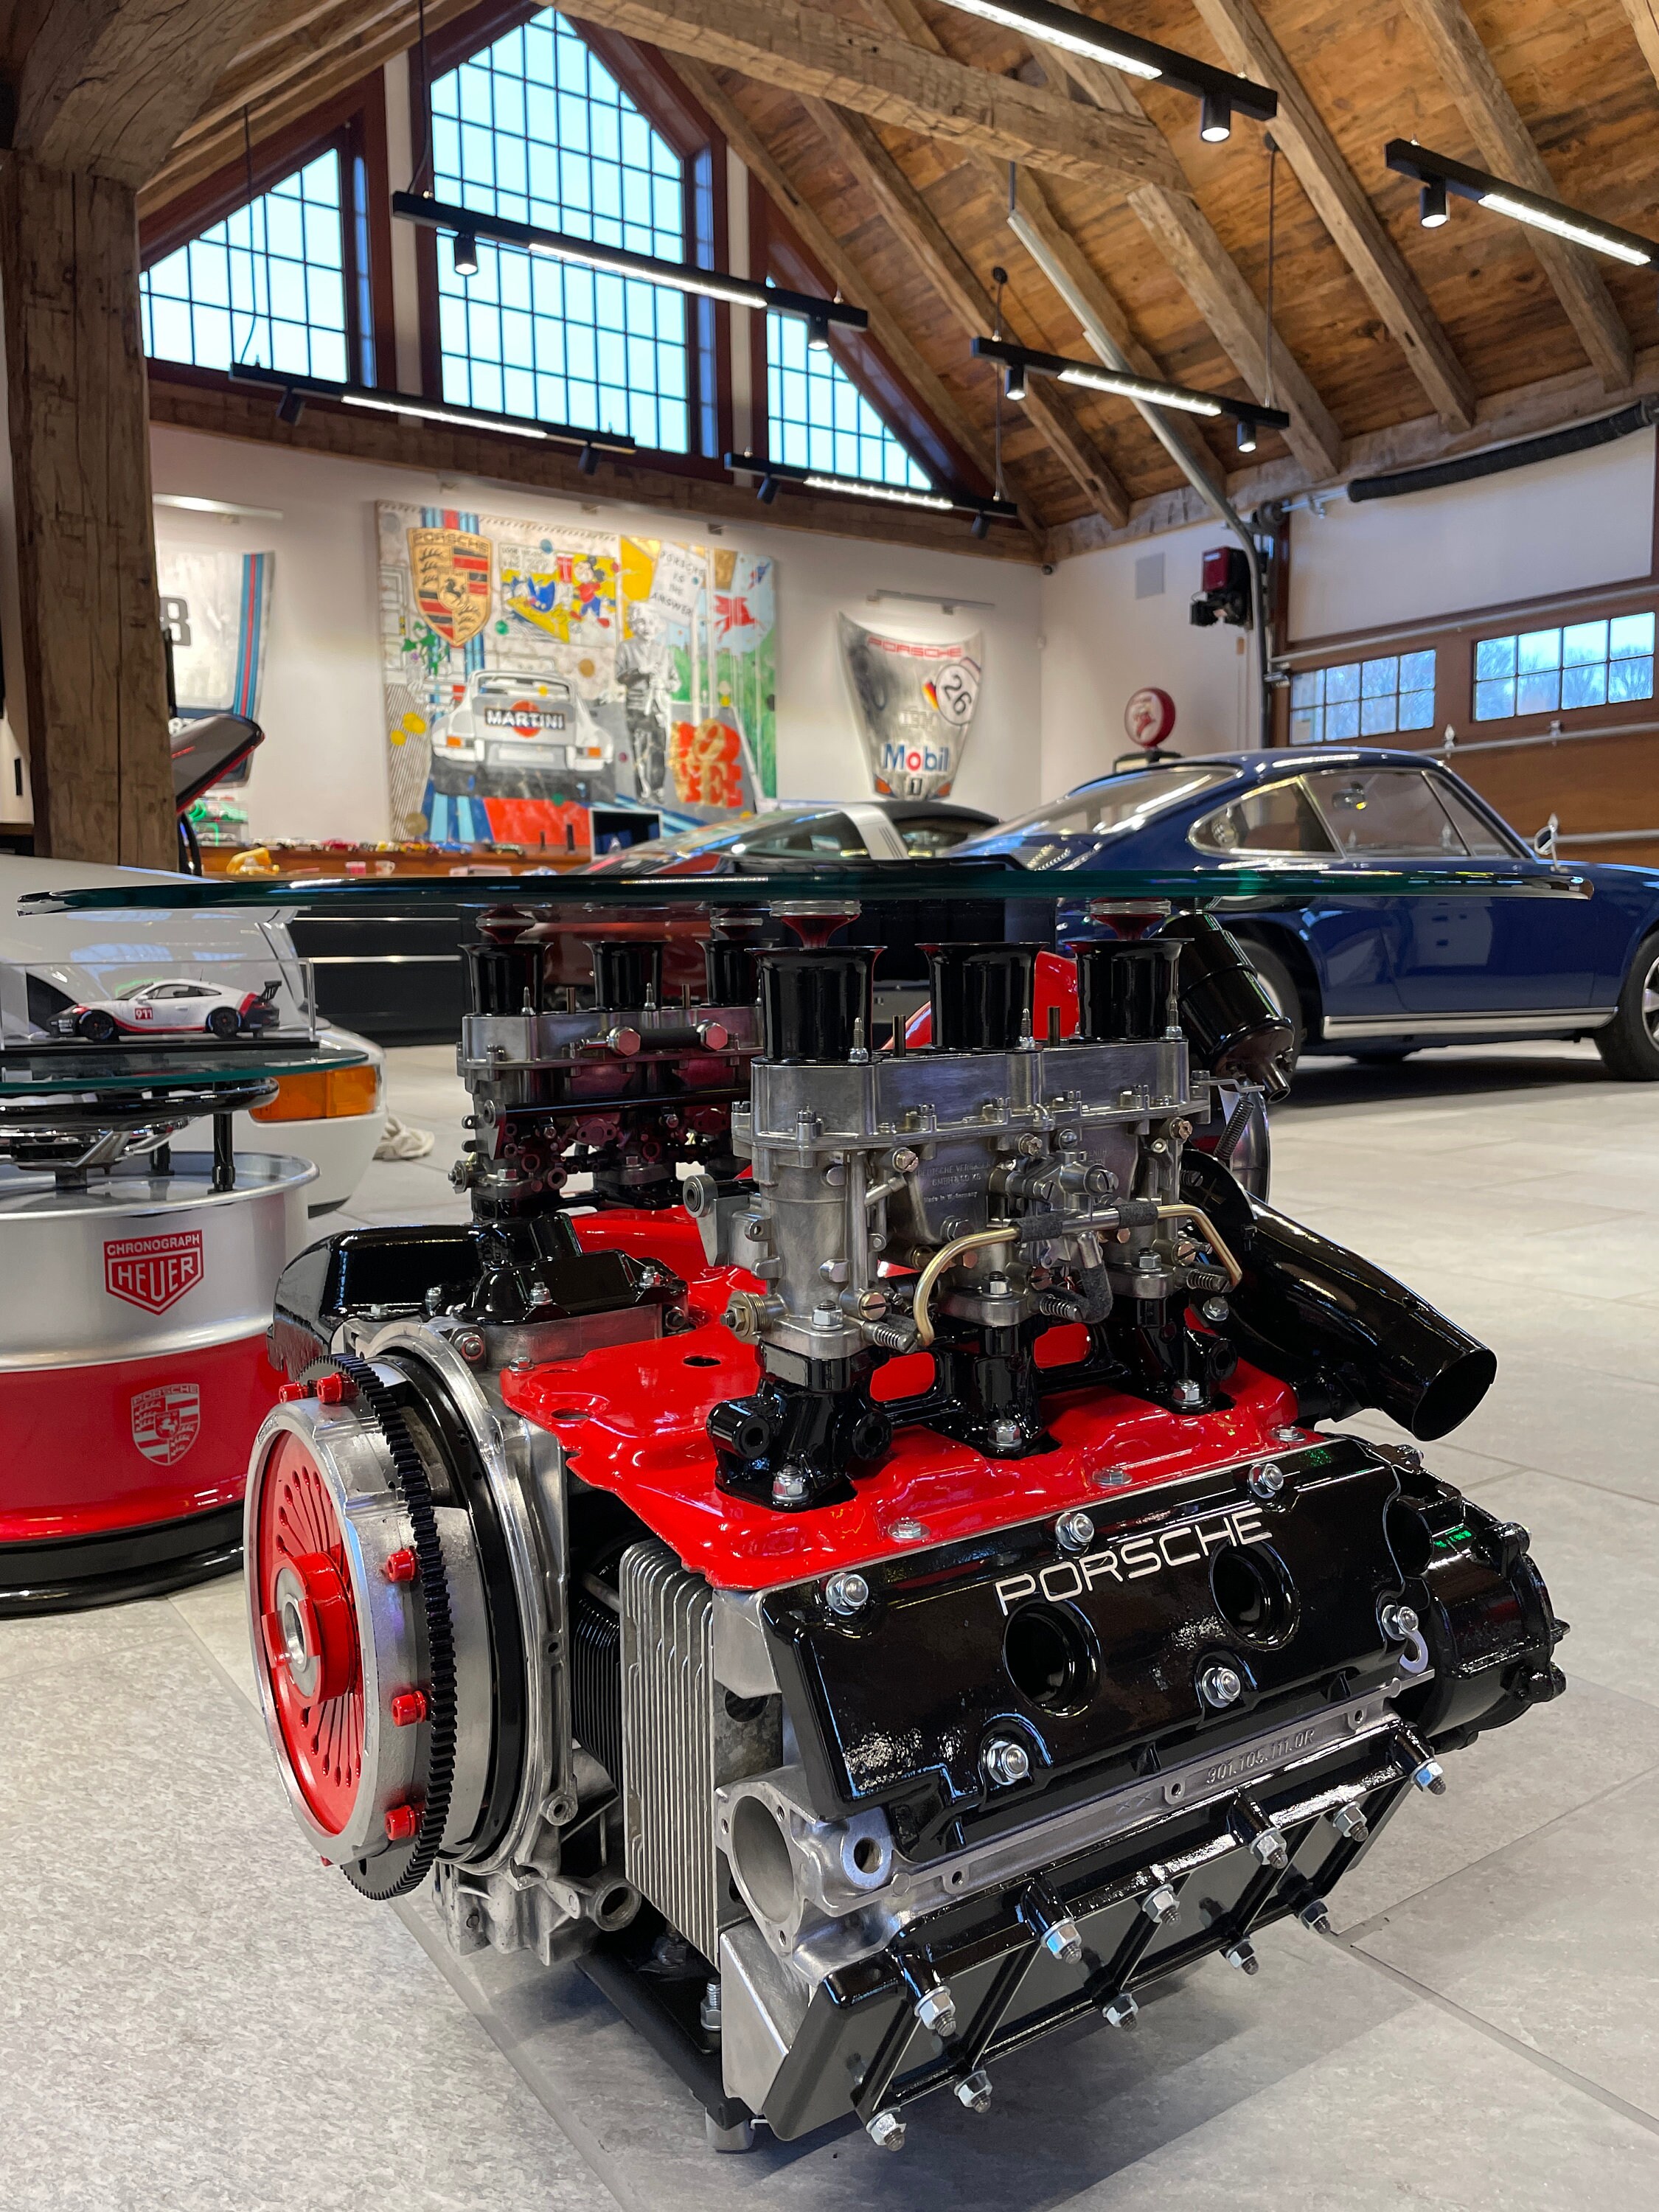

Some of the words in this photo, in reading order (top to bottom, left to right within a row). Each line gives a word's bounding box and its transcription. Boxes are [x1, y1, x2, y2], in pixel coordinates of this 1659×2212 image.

[413, 532, 490, 553] PORSCHE
[649, 592, 693, 617] ANSWER
[868, 637, 962, 658] PORSCHE
[944, 674, 973, 716] 26
[487, 709, 563, 729] MARTINI
[883, 743, 949, 772] Mobil
[135, 1009, 153, 1019] 911
[107, 1234, 200, 1256] CHRONOGRAPH
[118, 1256, 195, 1302] HEUER
[133, 1385, 198, 1405] PORSCHE
[995, 1508, 1273, 1617] PORSCHE
